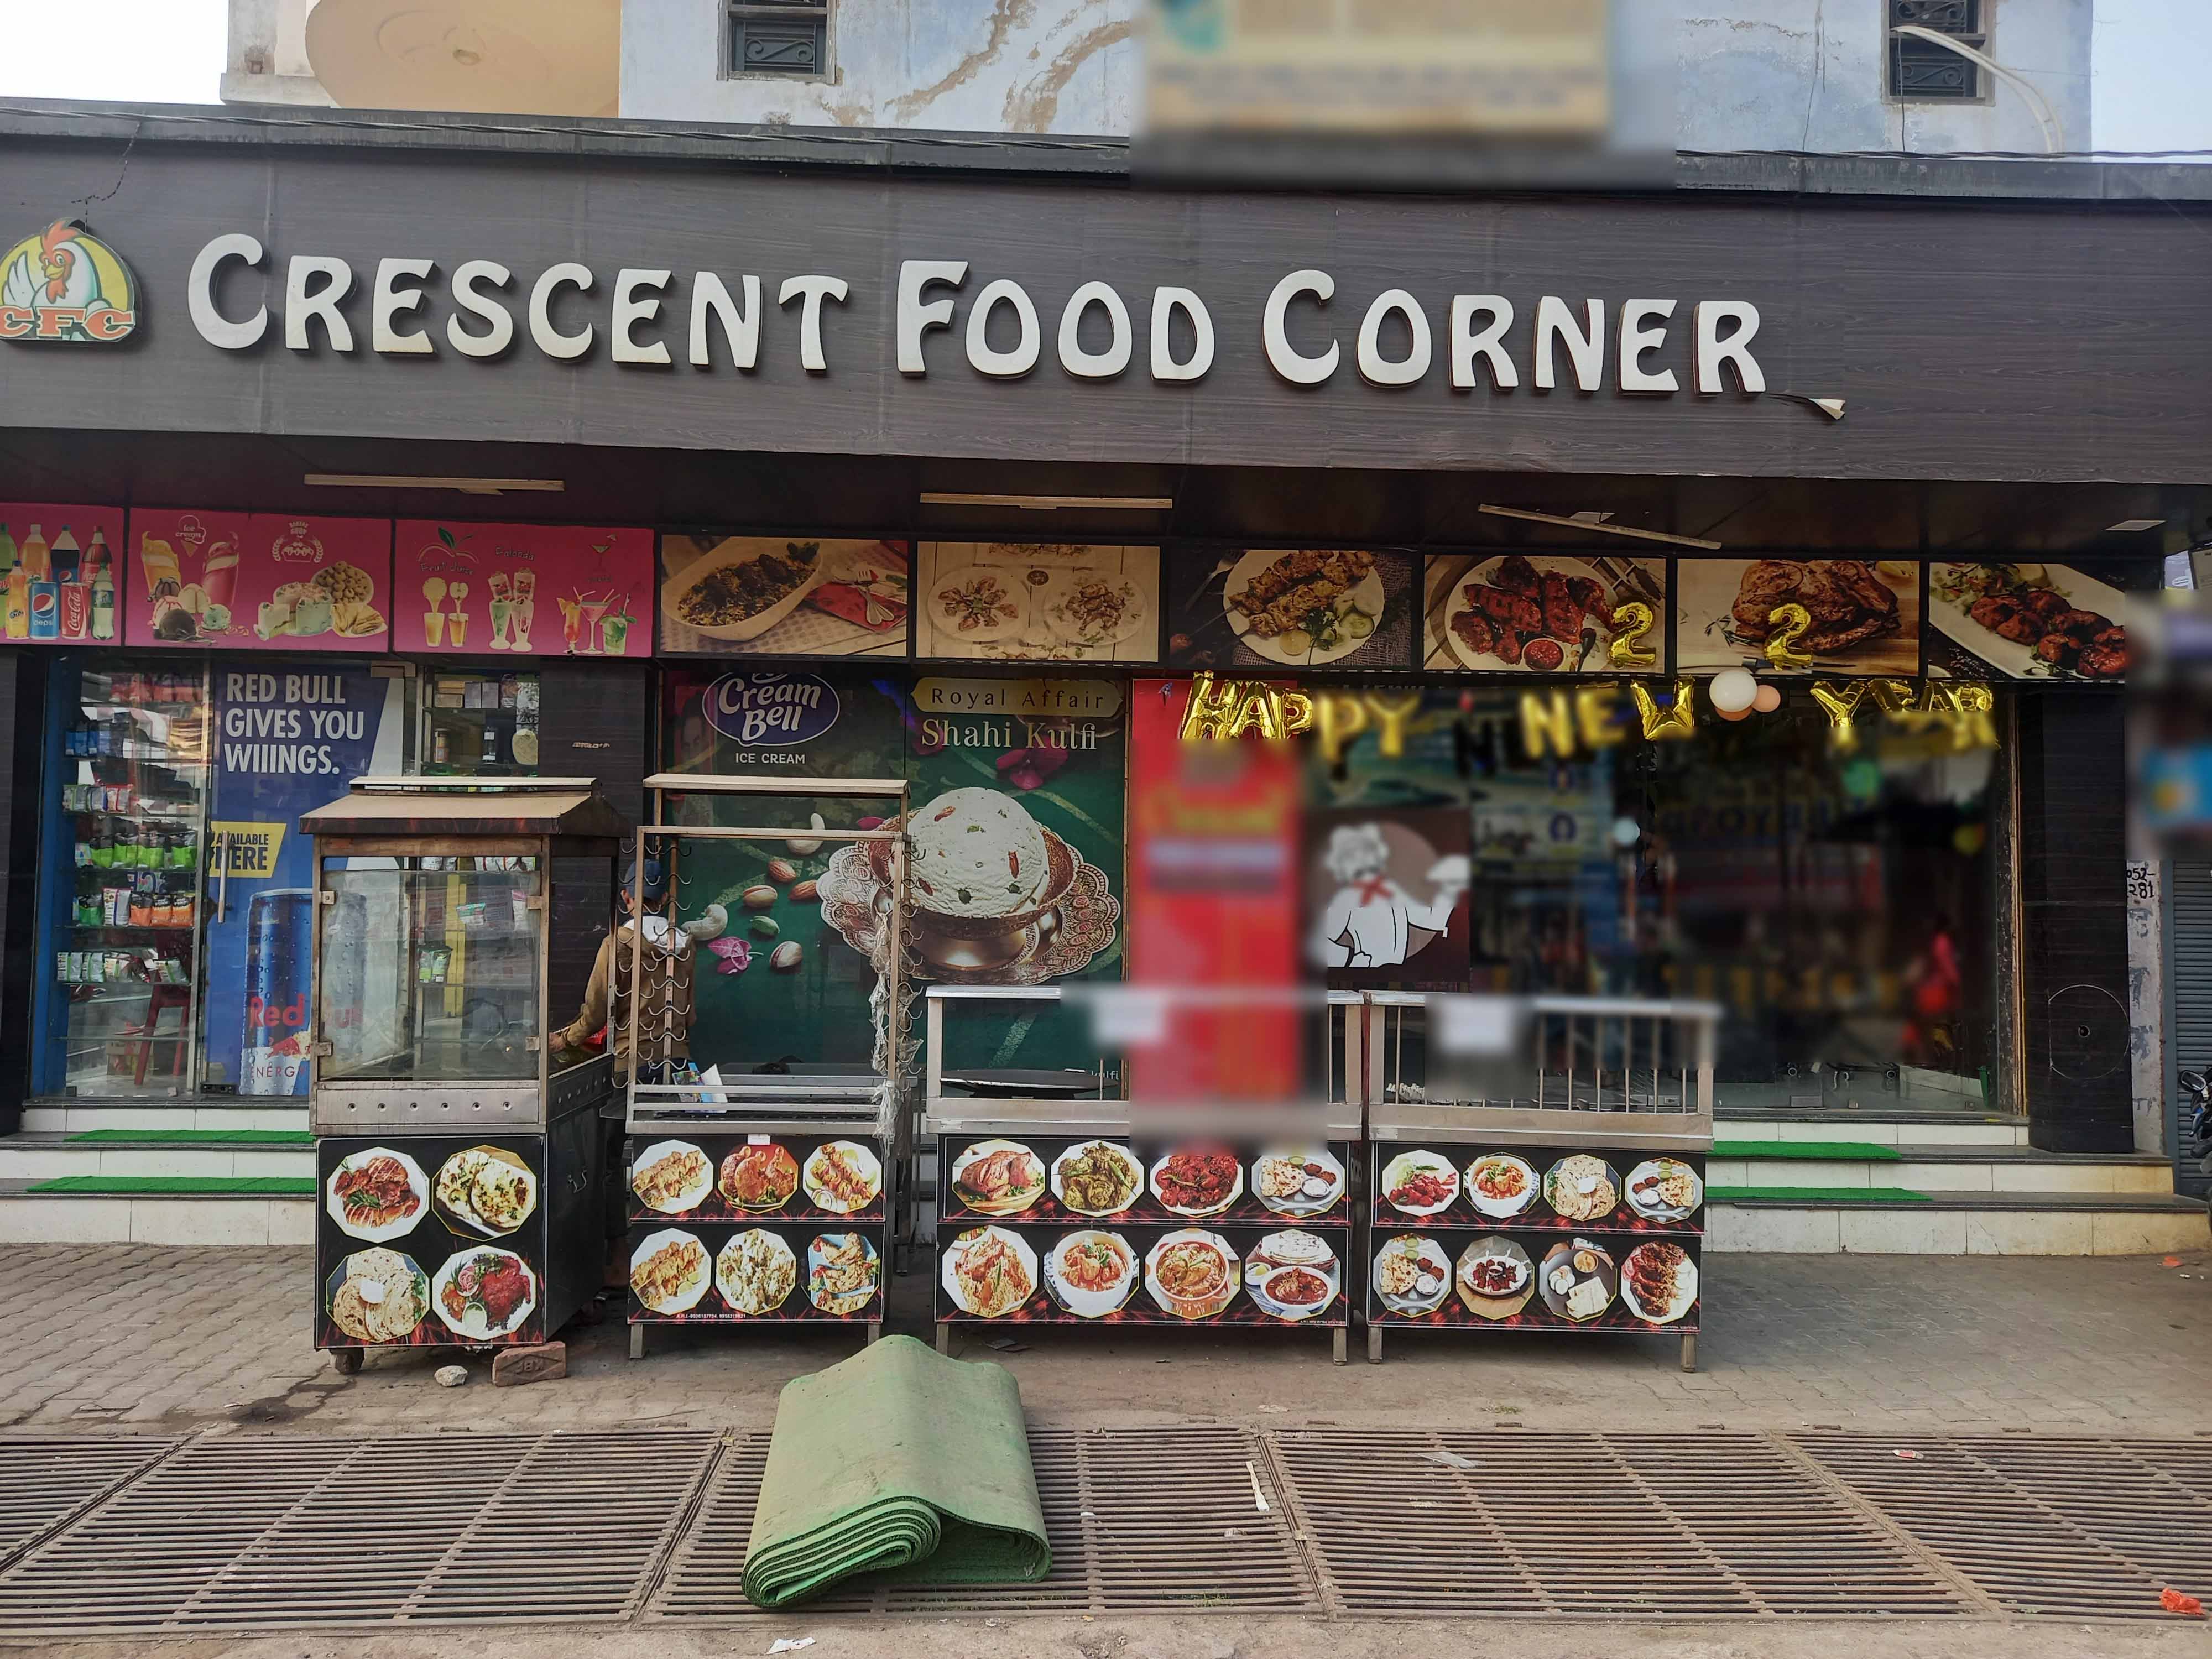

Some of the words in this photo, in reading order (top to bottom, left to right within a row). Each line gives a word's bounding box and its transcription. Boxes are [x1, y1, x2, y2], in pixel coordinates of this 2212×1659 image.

[0, 305, 135, 341] CFC
[187, 233, 848, 372] CRESCENT
[896, 260, 1216, 382] FOOD
[1261, 269, 1767, 394] CORNER
[226, 673, 276, 702] RED
[285, 675, 346, 704] BULL
[719, 678, 821, 714] Cream
[931, 688, 1005, 709] Royal
[1022, 690, 1104, 708] Affair
[225, 708, 301, 739] GIVES
[309, 710, 364, 740] YOU
[742, 706, 802, 741] Bell
[921, 719, 1012, 748] Shahi
[1026, 722, 1097, 750] Kulfi
[224, 744, 340, 775] WIIINGS.
[735, 753, 756, 763] ICE
[761, 753, 805, 764] CREAM
[216, 833, 269, 845] AAILABLE
[249, 993, 305, 1027] Red
